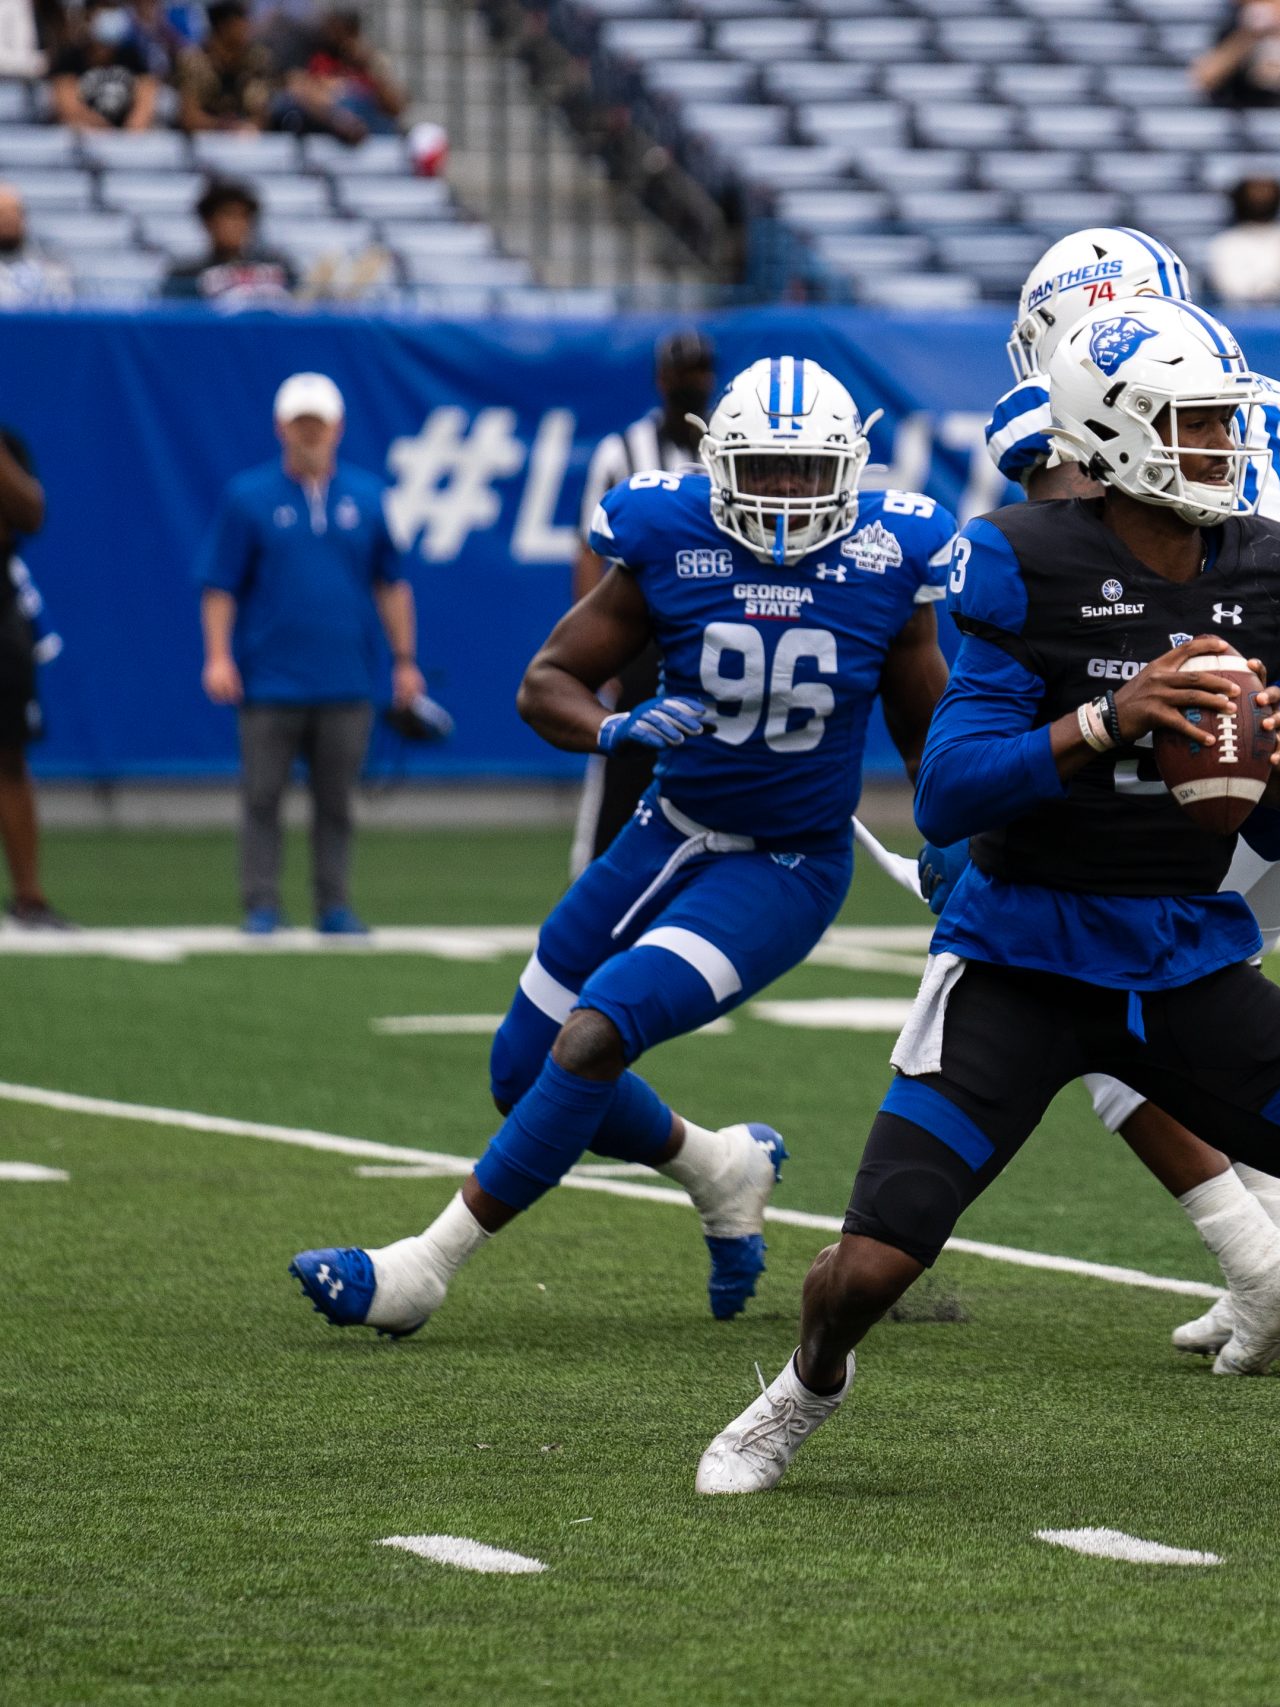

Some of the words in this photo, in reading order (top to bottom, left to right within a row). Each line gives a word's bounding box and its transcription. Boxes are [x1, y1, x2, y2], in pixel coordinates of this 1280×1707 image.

[1028, 260, 1123, 307] PANTHERS
[1083, 282, 1116, 307] 74
[676, 550, 733, 578] SBC
[950, 537, 972, 594] 3
[733, 583, 813, 604] GEORGIA
[744, 599, 801, 617] STATE
[700, 622, 838, 753] 96
